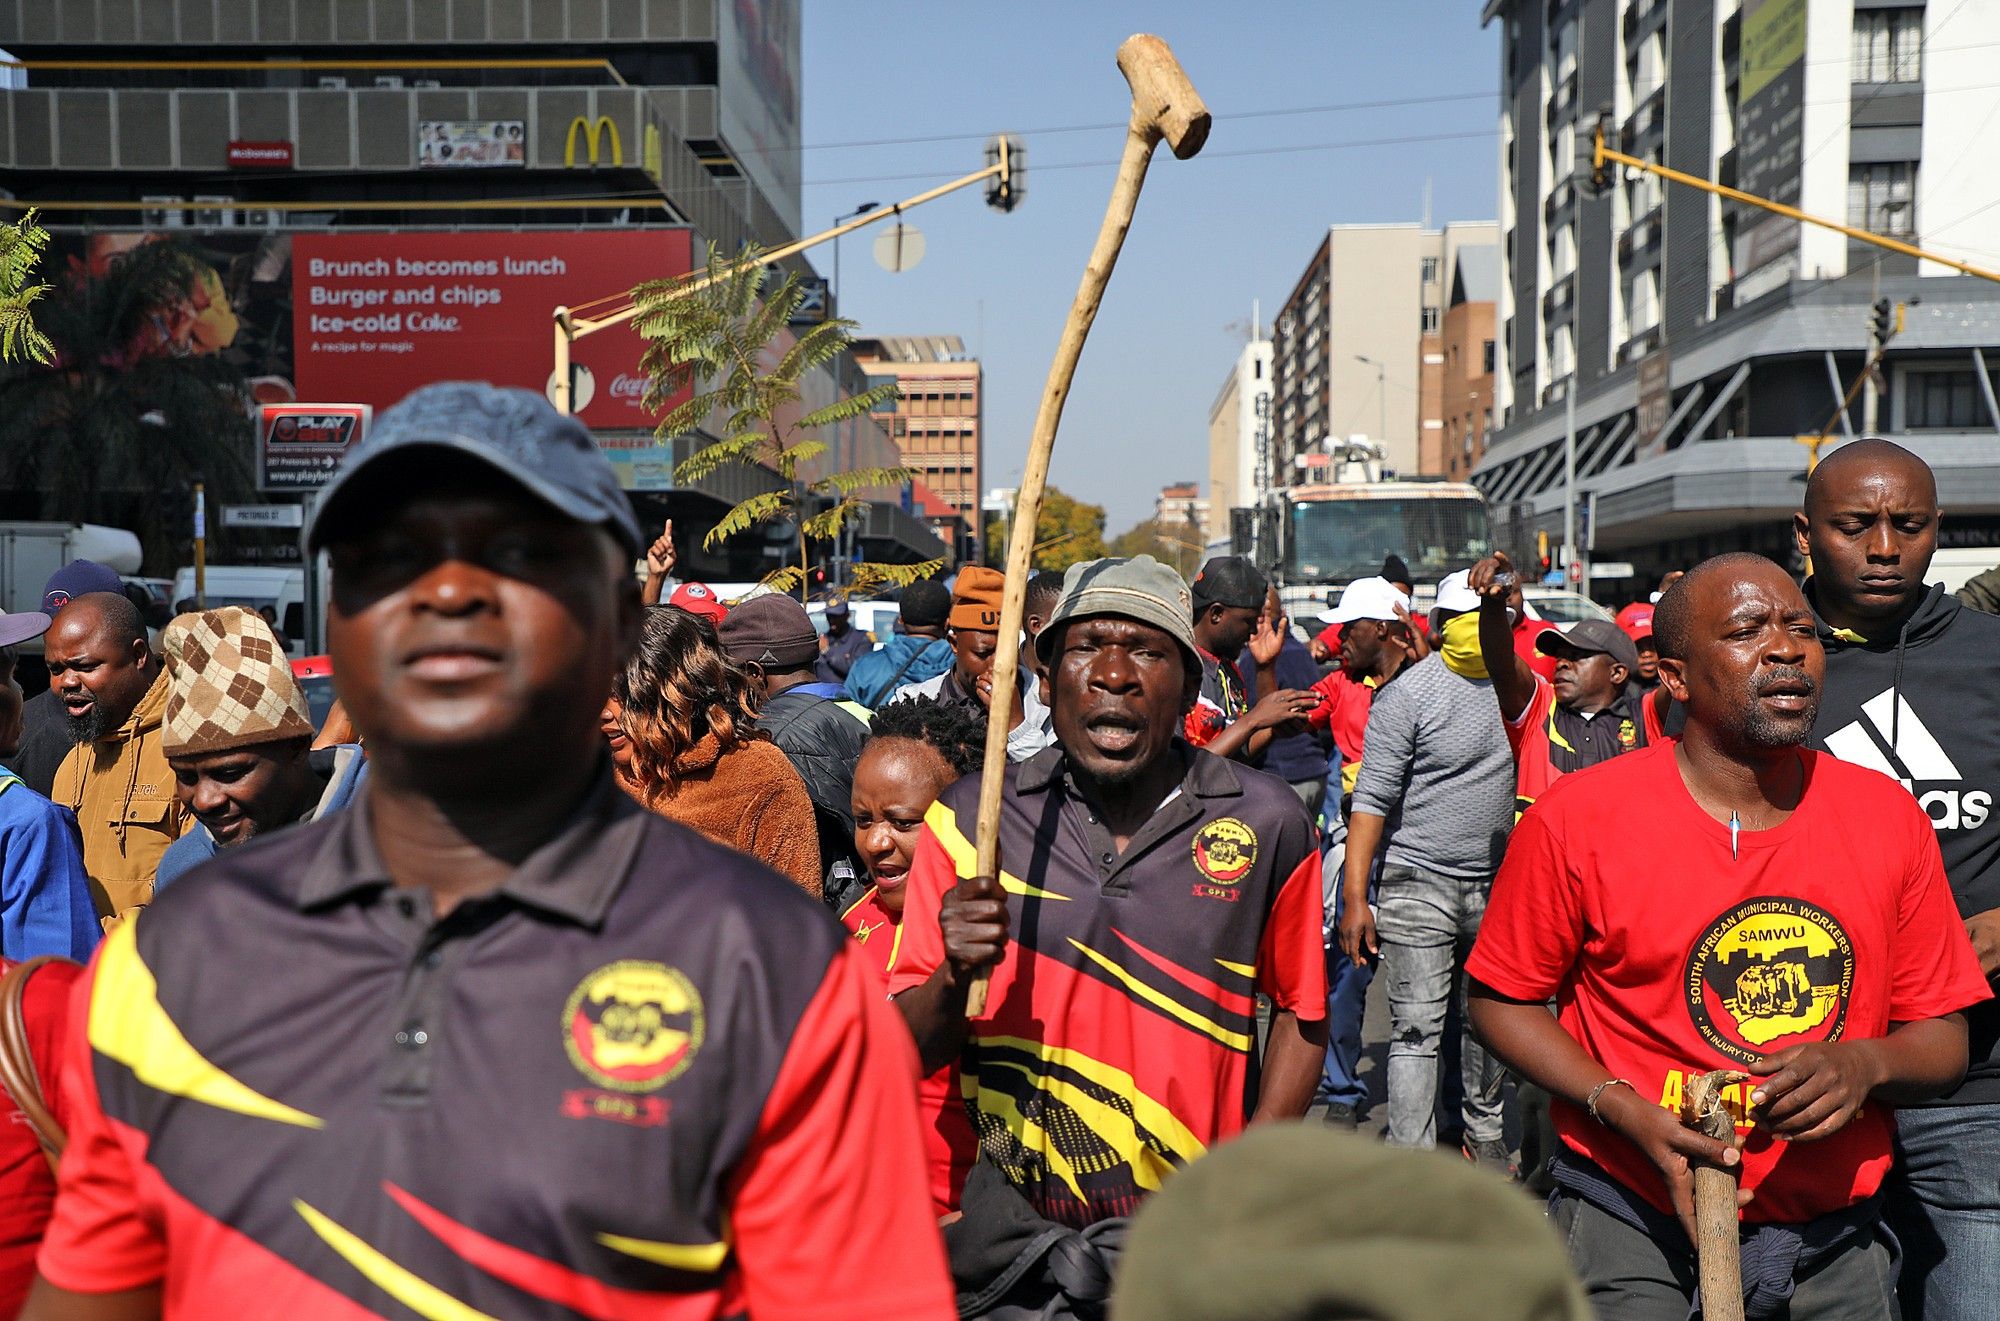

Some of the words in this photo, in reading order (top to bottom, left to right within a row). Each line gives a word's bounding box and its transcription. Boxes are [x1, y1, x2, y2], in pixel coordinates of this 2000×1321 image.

[309, 258, 390, 277] Brunch
[396, 257, 498, 276] becomes
[504, 256, 566, 275] lunch
[310, 286, 389, 309] Burger
[392, 285, 435, 304] and
[440, 285, 502, 307] chips
[310, 313, 401, 333] Ice-cold
[311, 342, 320, 352] A
[322, 342, 357, 353] recipe
[360, 342, 377, 352] for
[379, 342, 414, 353] magic
[600, 439, 655, 448] URGERY
[270, 470, 334, 484] www.playbet
[1738, 925, 1805, 943] SAMWU
[1690, 962, 1704, 1005] SOUTH
[1697, 915, 1738, 962] AFRICAN
[1736, 902, 1796, 921] MUNICIPAL
[1799, 905, 1852, 956] WORKERS'
[1841, 958, 1852, 998] UNION
[1700, 1024, 1714, 1038] AN
[1709, 1033, 1739, 1057] INJURY
[1742, 1051, 1755, 1063] TO
[1835, 1020, 1845, 1038] ALL
